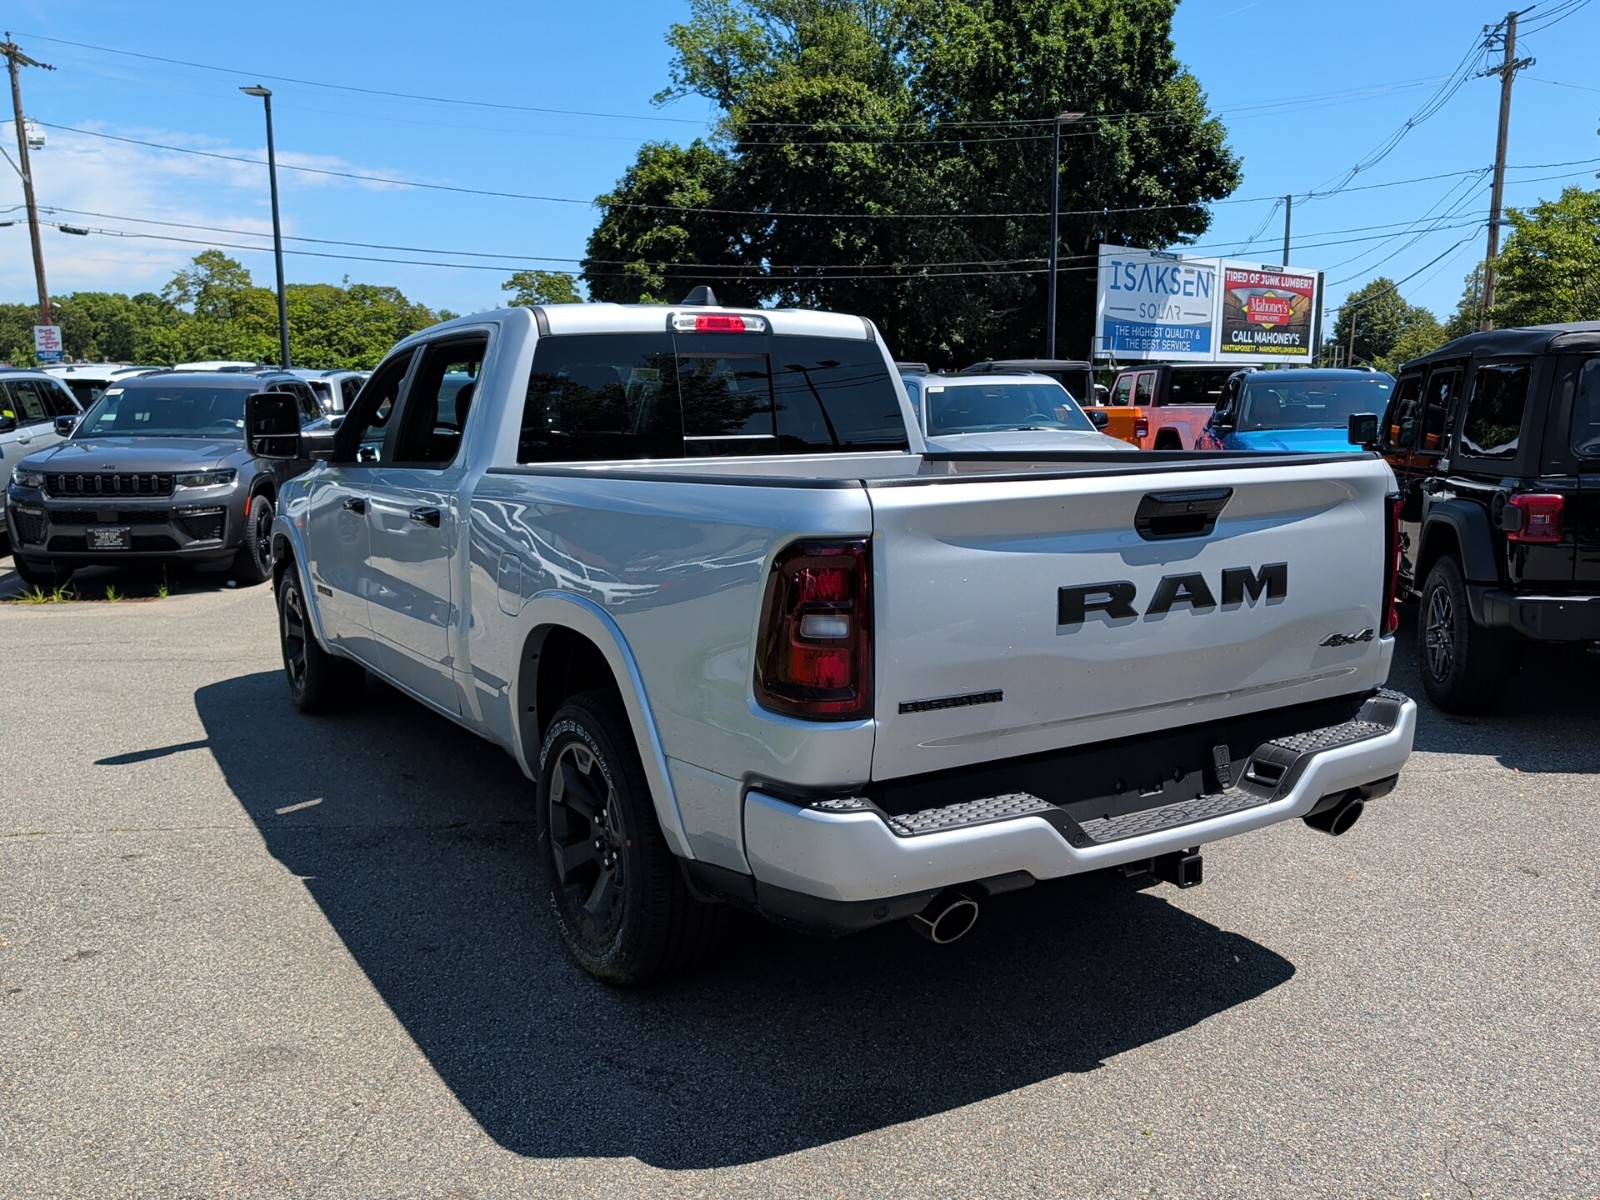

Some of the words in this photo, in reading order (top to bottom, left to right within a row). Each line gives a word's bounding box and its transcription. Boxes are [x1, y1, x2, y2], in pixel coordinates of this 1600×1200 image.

[1109, 260, 1211, 298] ISAKSEN
[1226, 270, 1248, 283] TIRED
[1249, 273, 1260, 284] OF
[1261, 275, 1280, 287] JUNK
[1281, 276, 1313, 290] LUMBER?
[1139, 302, 1181, 320] SOLAR
[1250, 298, 1288, 313] Mahoney's
[1115, 325, 1130, 336] THE
[1132, 326, 1163, 338] HIGHEST
[1165, 328, 1194, 339] QUALITY
[1195, 330, 1201, 340] &
[1231, 330, 1253, 343] CALL
[1254, 332, 1300, 345] MAHONEY'S
[1125, 338, 1140, 349] THE
[1142, 339, 1160, 350] BEST
[1161, 341, 1191, 351] SERVICE
[1058, 562, 1288, 625] RAM
